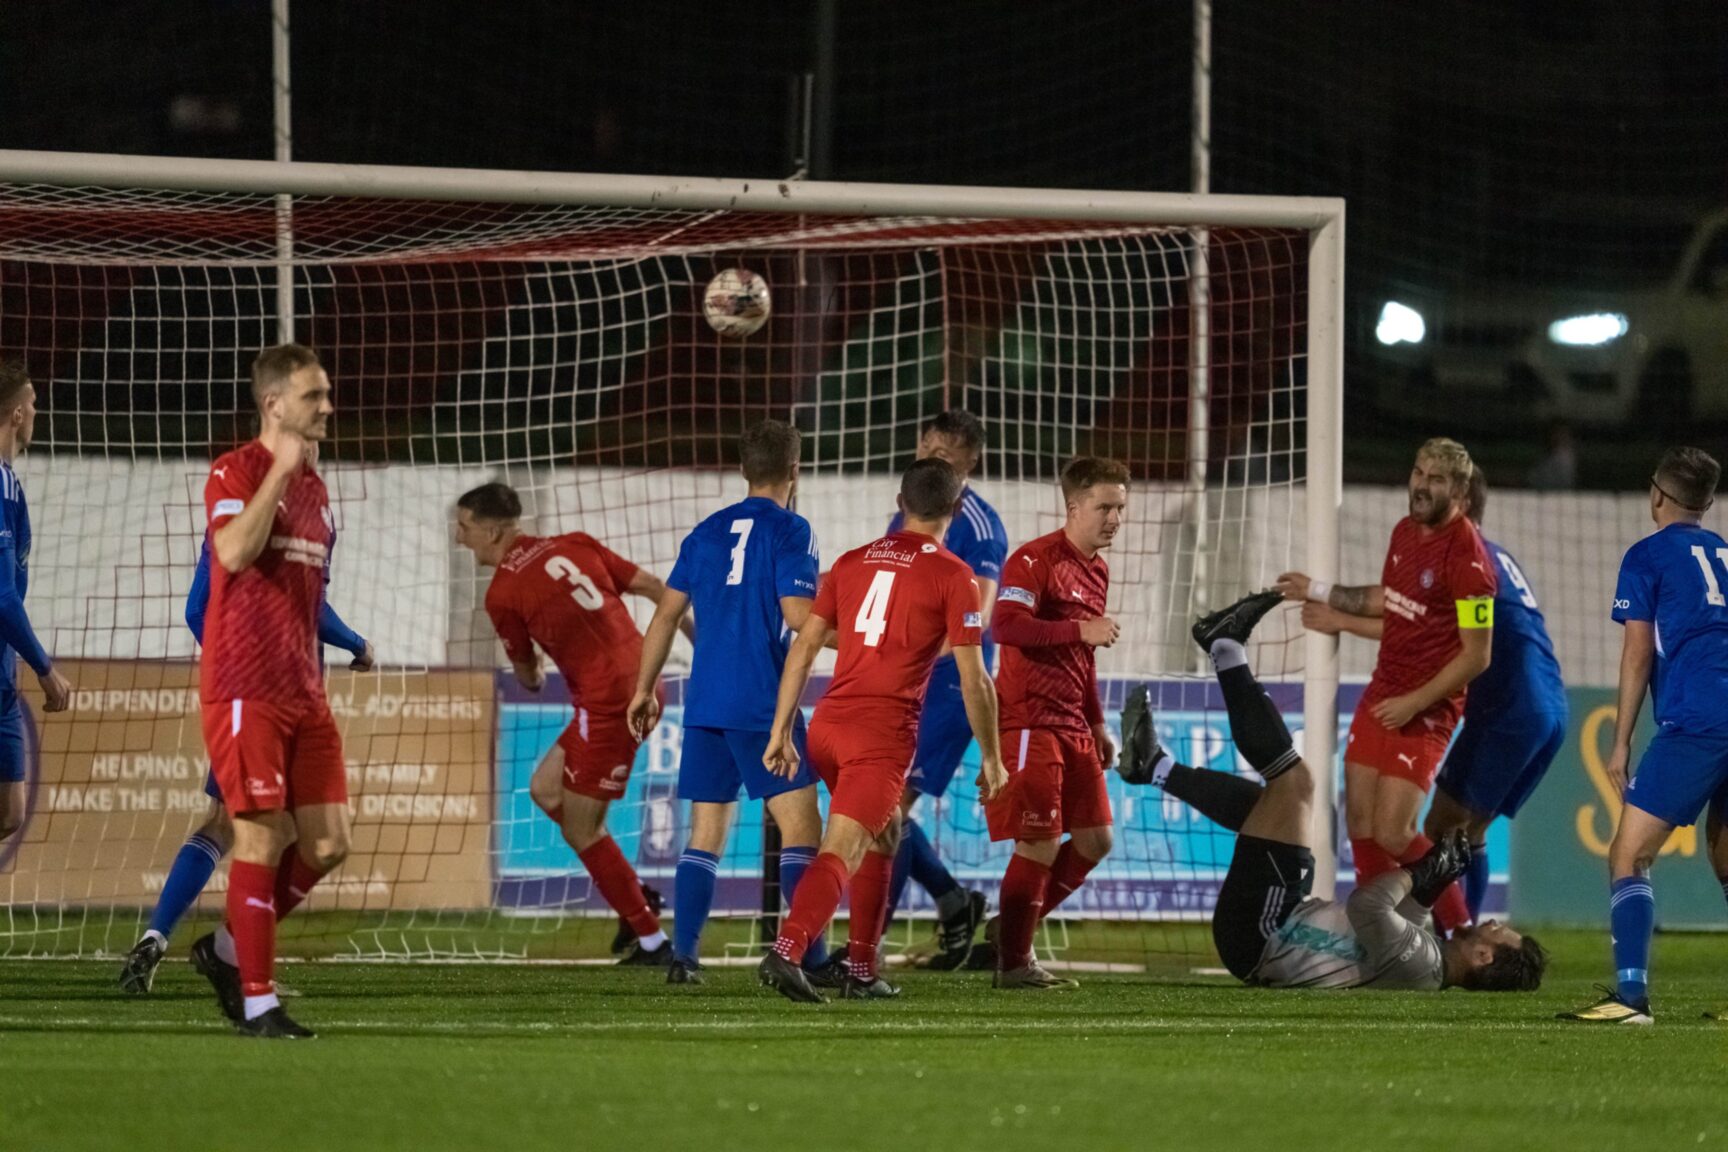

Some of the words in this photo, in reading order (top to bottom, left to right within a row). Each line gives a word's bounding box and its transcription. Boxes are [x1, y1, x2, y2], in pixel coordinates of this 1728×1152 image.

[726, 518, 754, 586] 7
[864, 548, 918, 563] Financial
[872, 538, 899, 551] City
[544, 555, 604, 611] 3
[1496, 551, 1538, 609] 9
[854, 569, 896, 647] 4
[1474, 602, 1489, 624] C
[1613, 598, 1630, 609] XD
[92, 753, 189, 779] HELPING
[49, 787, 113, 811] MAKE
[118, 788, 161, 811] THE
